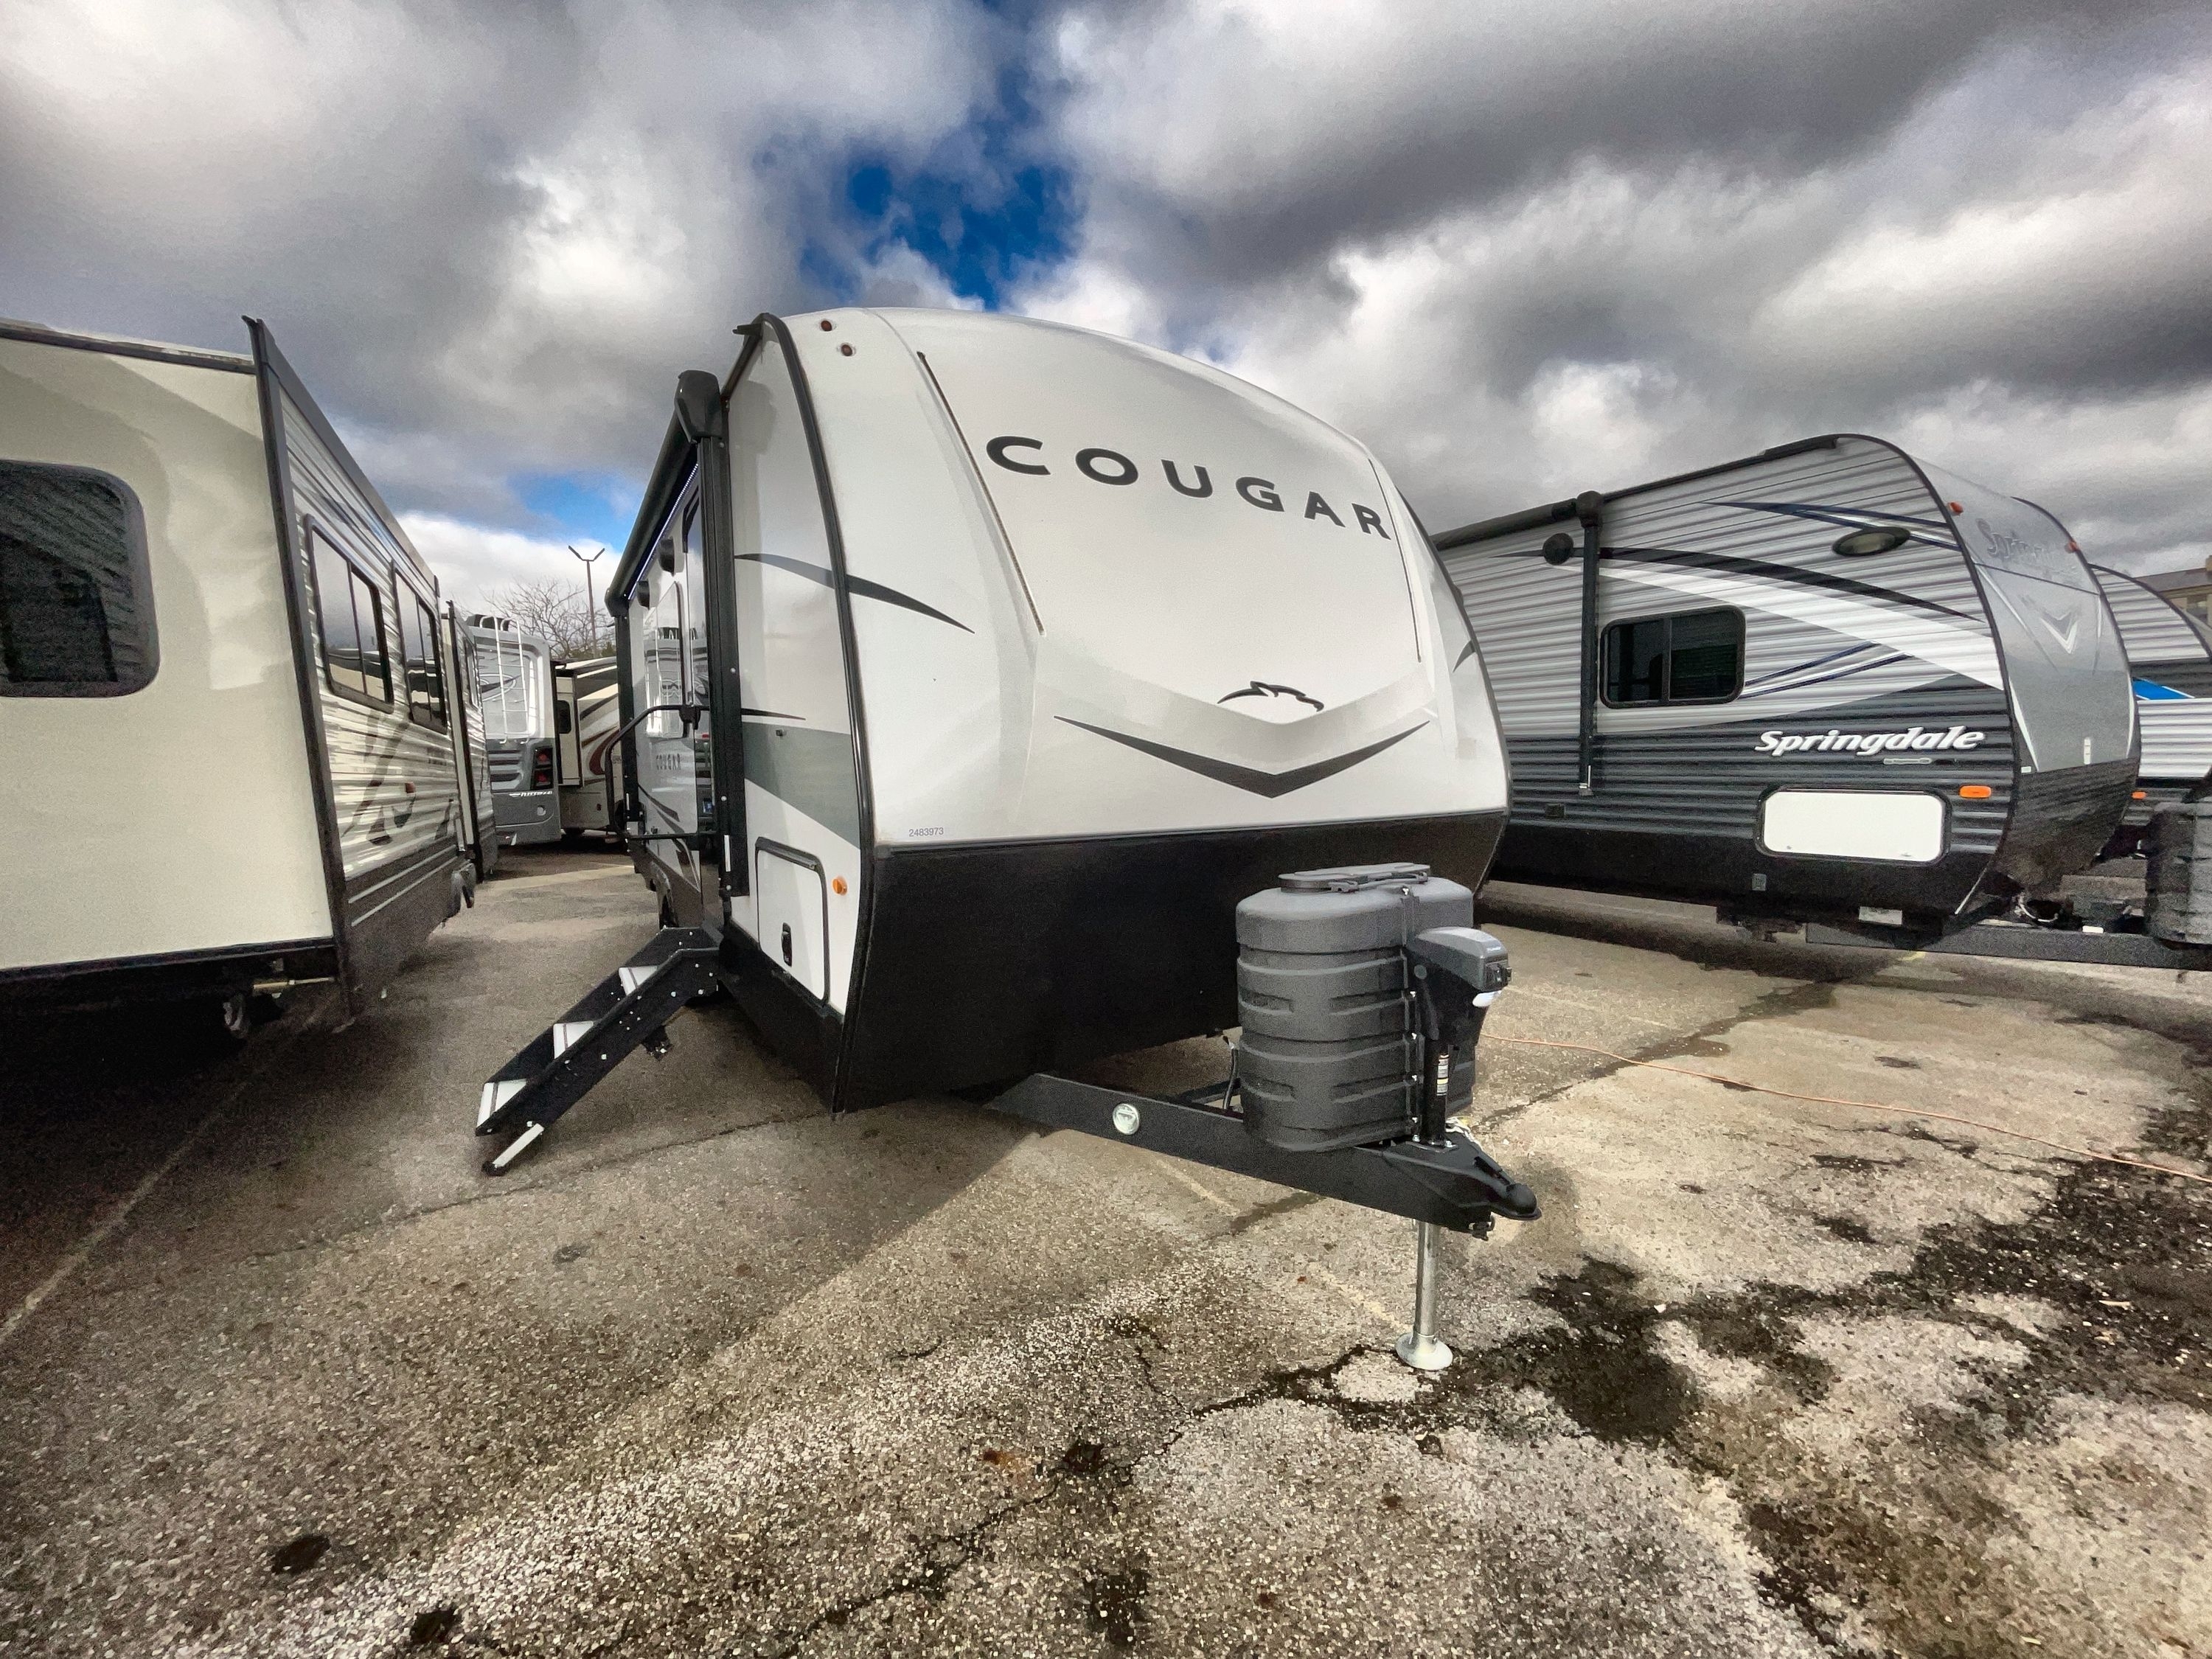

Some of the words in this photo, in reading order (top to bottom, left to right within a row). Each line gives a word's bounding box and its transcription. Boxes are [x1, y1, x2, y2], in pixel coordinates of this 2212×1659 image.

[986, 435, 1391, 540] COUGAR
[1754, 726, 1986, 757] Springdale
[908, 827, 944, 838] 2483973
